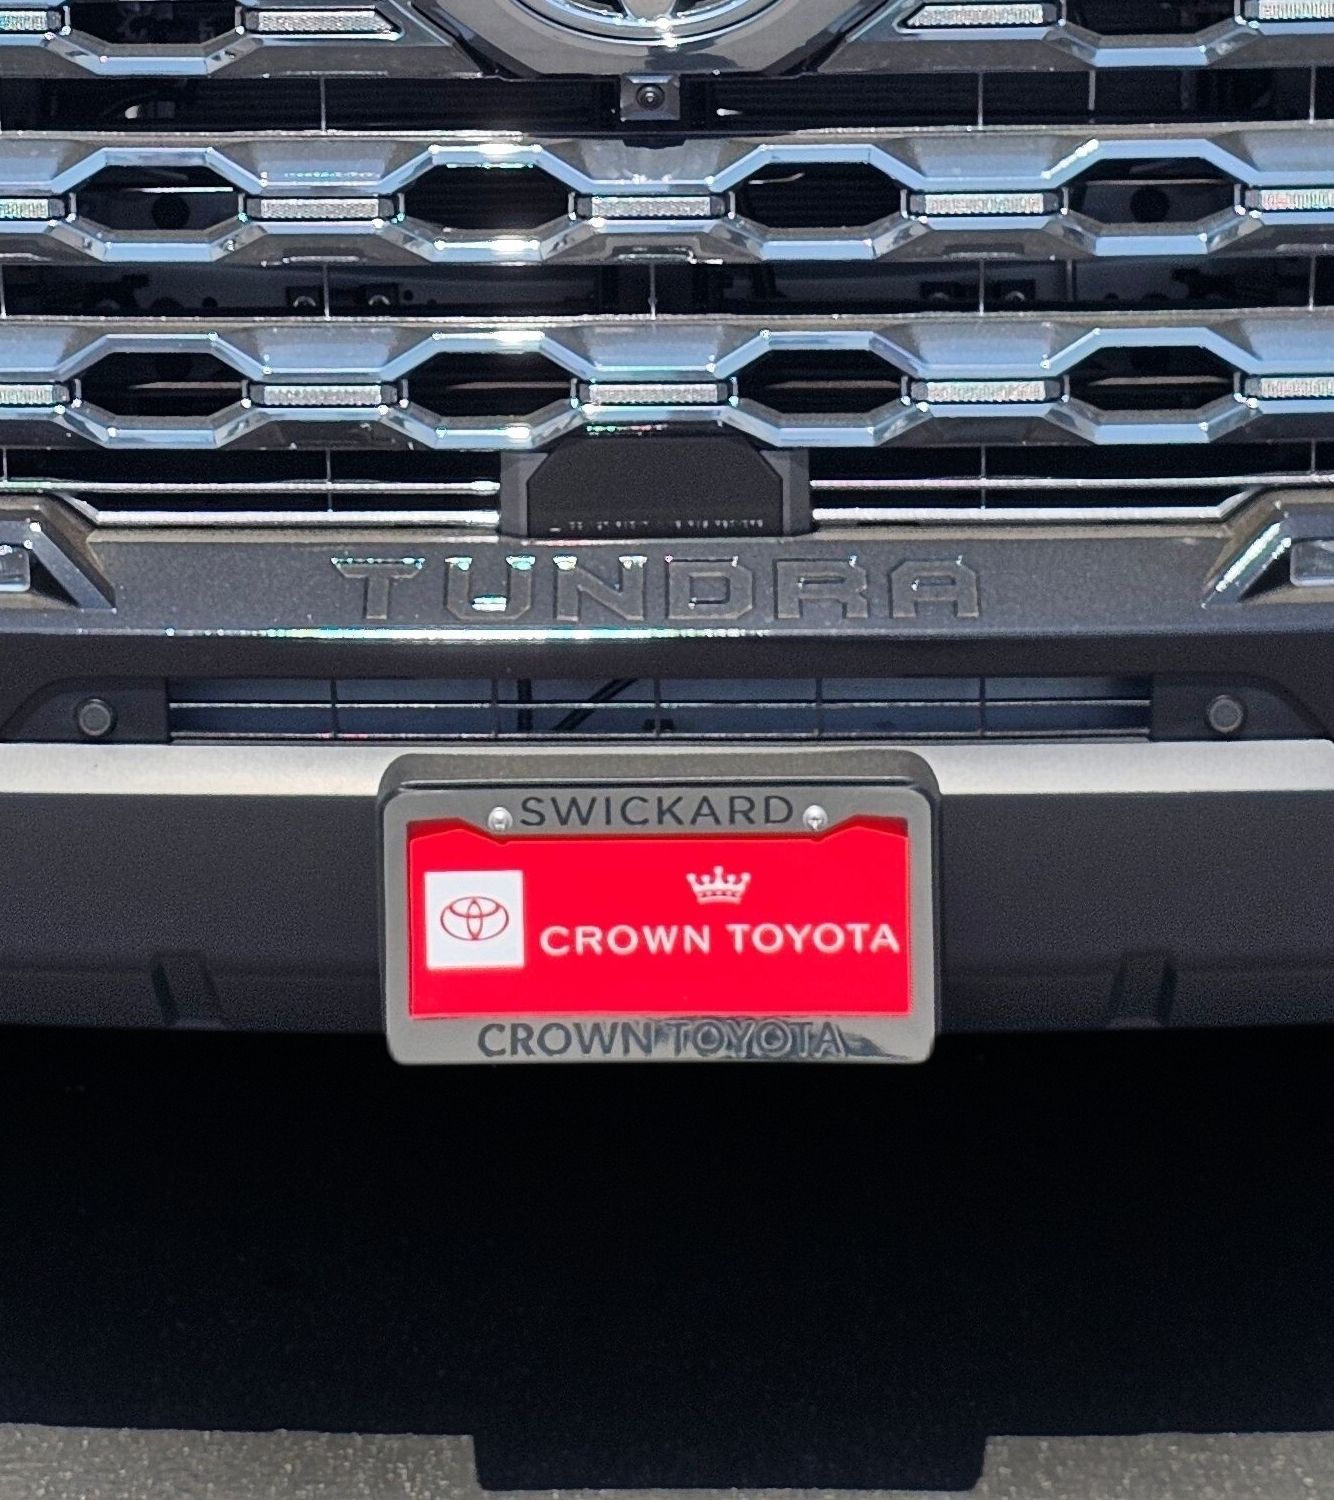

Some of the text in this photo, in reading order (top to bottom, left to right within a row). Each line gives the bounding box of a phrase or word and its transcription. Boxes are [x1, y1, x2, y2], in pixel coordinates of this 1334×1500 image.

[332, 556, 981, 621] TUNDRA
[520, 795, 794, 828] SWICKARD
[539, 923, 900, 956] CROWN TOYOTA
[477, 1020, 847, 1059] CROWN TOYOTA
